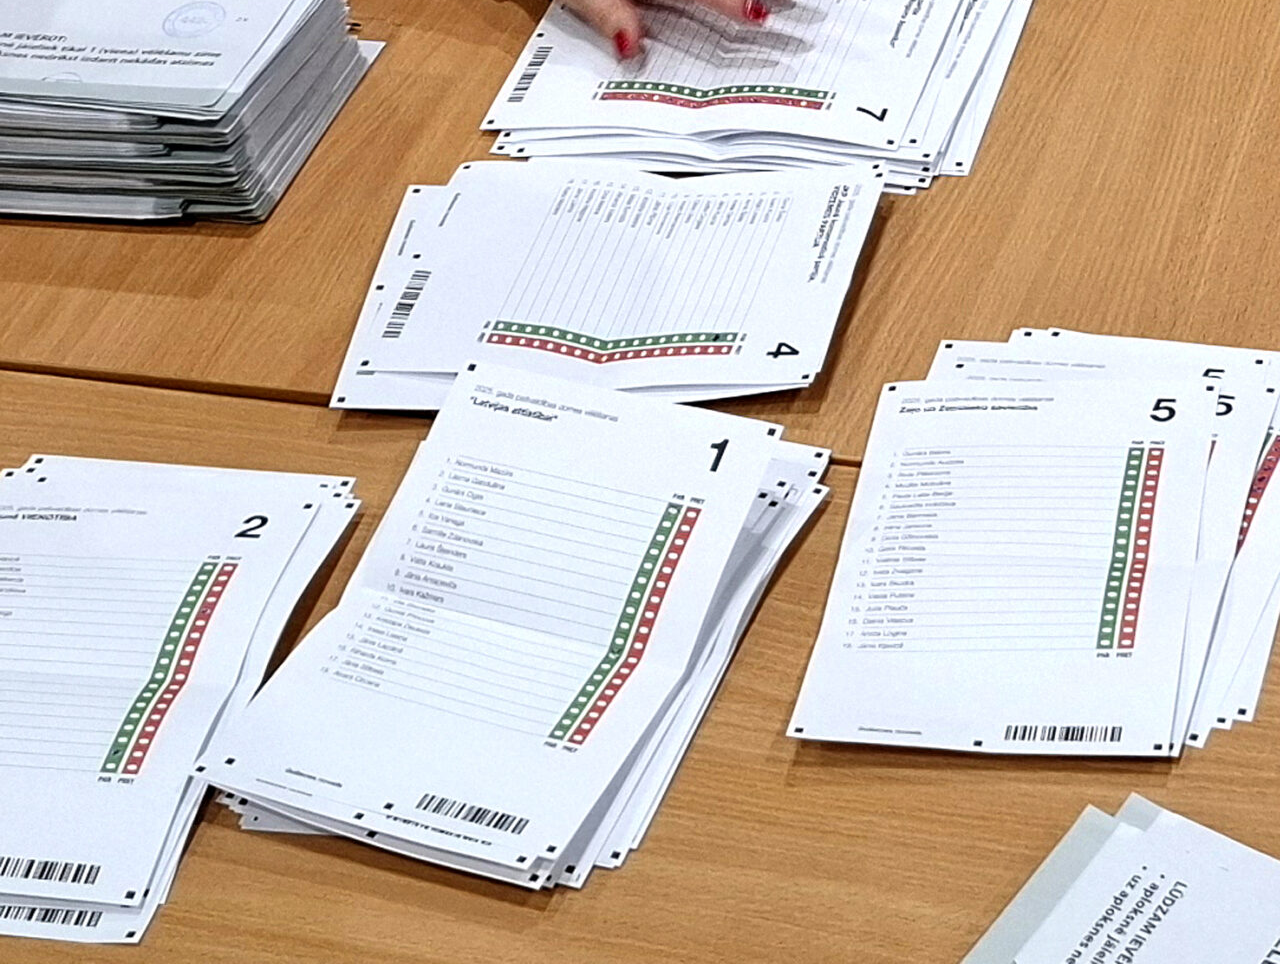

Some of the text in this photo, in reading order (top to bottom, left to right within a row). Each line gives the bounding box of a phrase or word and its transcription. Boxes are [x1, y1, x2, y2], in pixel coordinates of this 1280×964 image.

[856, 102, 888, 123] 7
[766, 341, 800, 359] 4
[1150, 398, 1177, 422] 5
[1215, 394, 1236, 416] 5
[709, 438, 730, 473] 1
[234, 514, 269, 539] 2
[1125, 874, 1142, 891] uz
[1079, 890, 1129, 949] aploksnes
[1114, 882, 1159, 936] aploksnē
[1140, 879, 1188, 936] LŪDZAM
